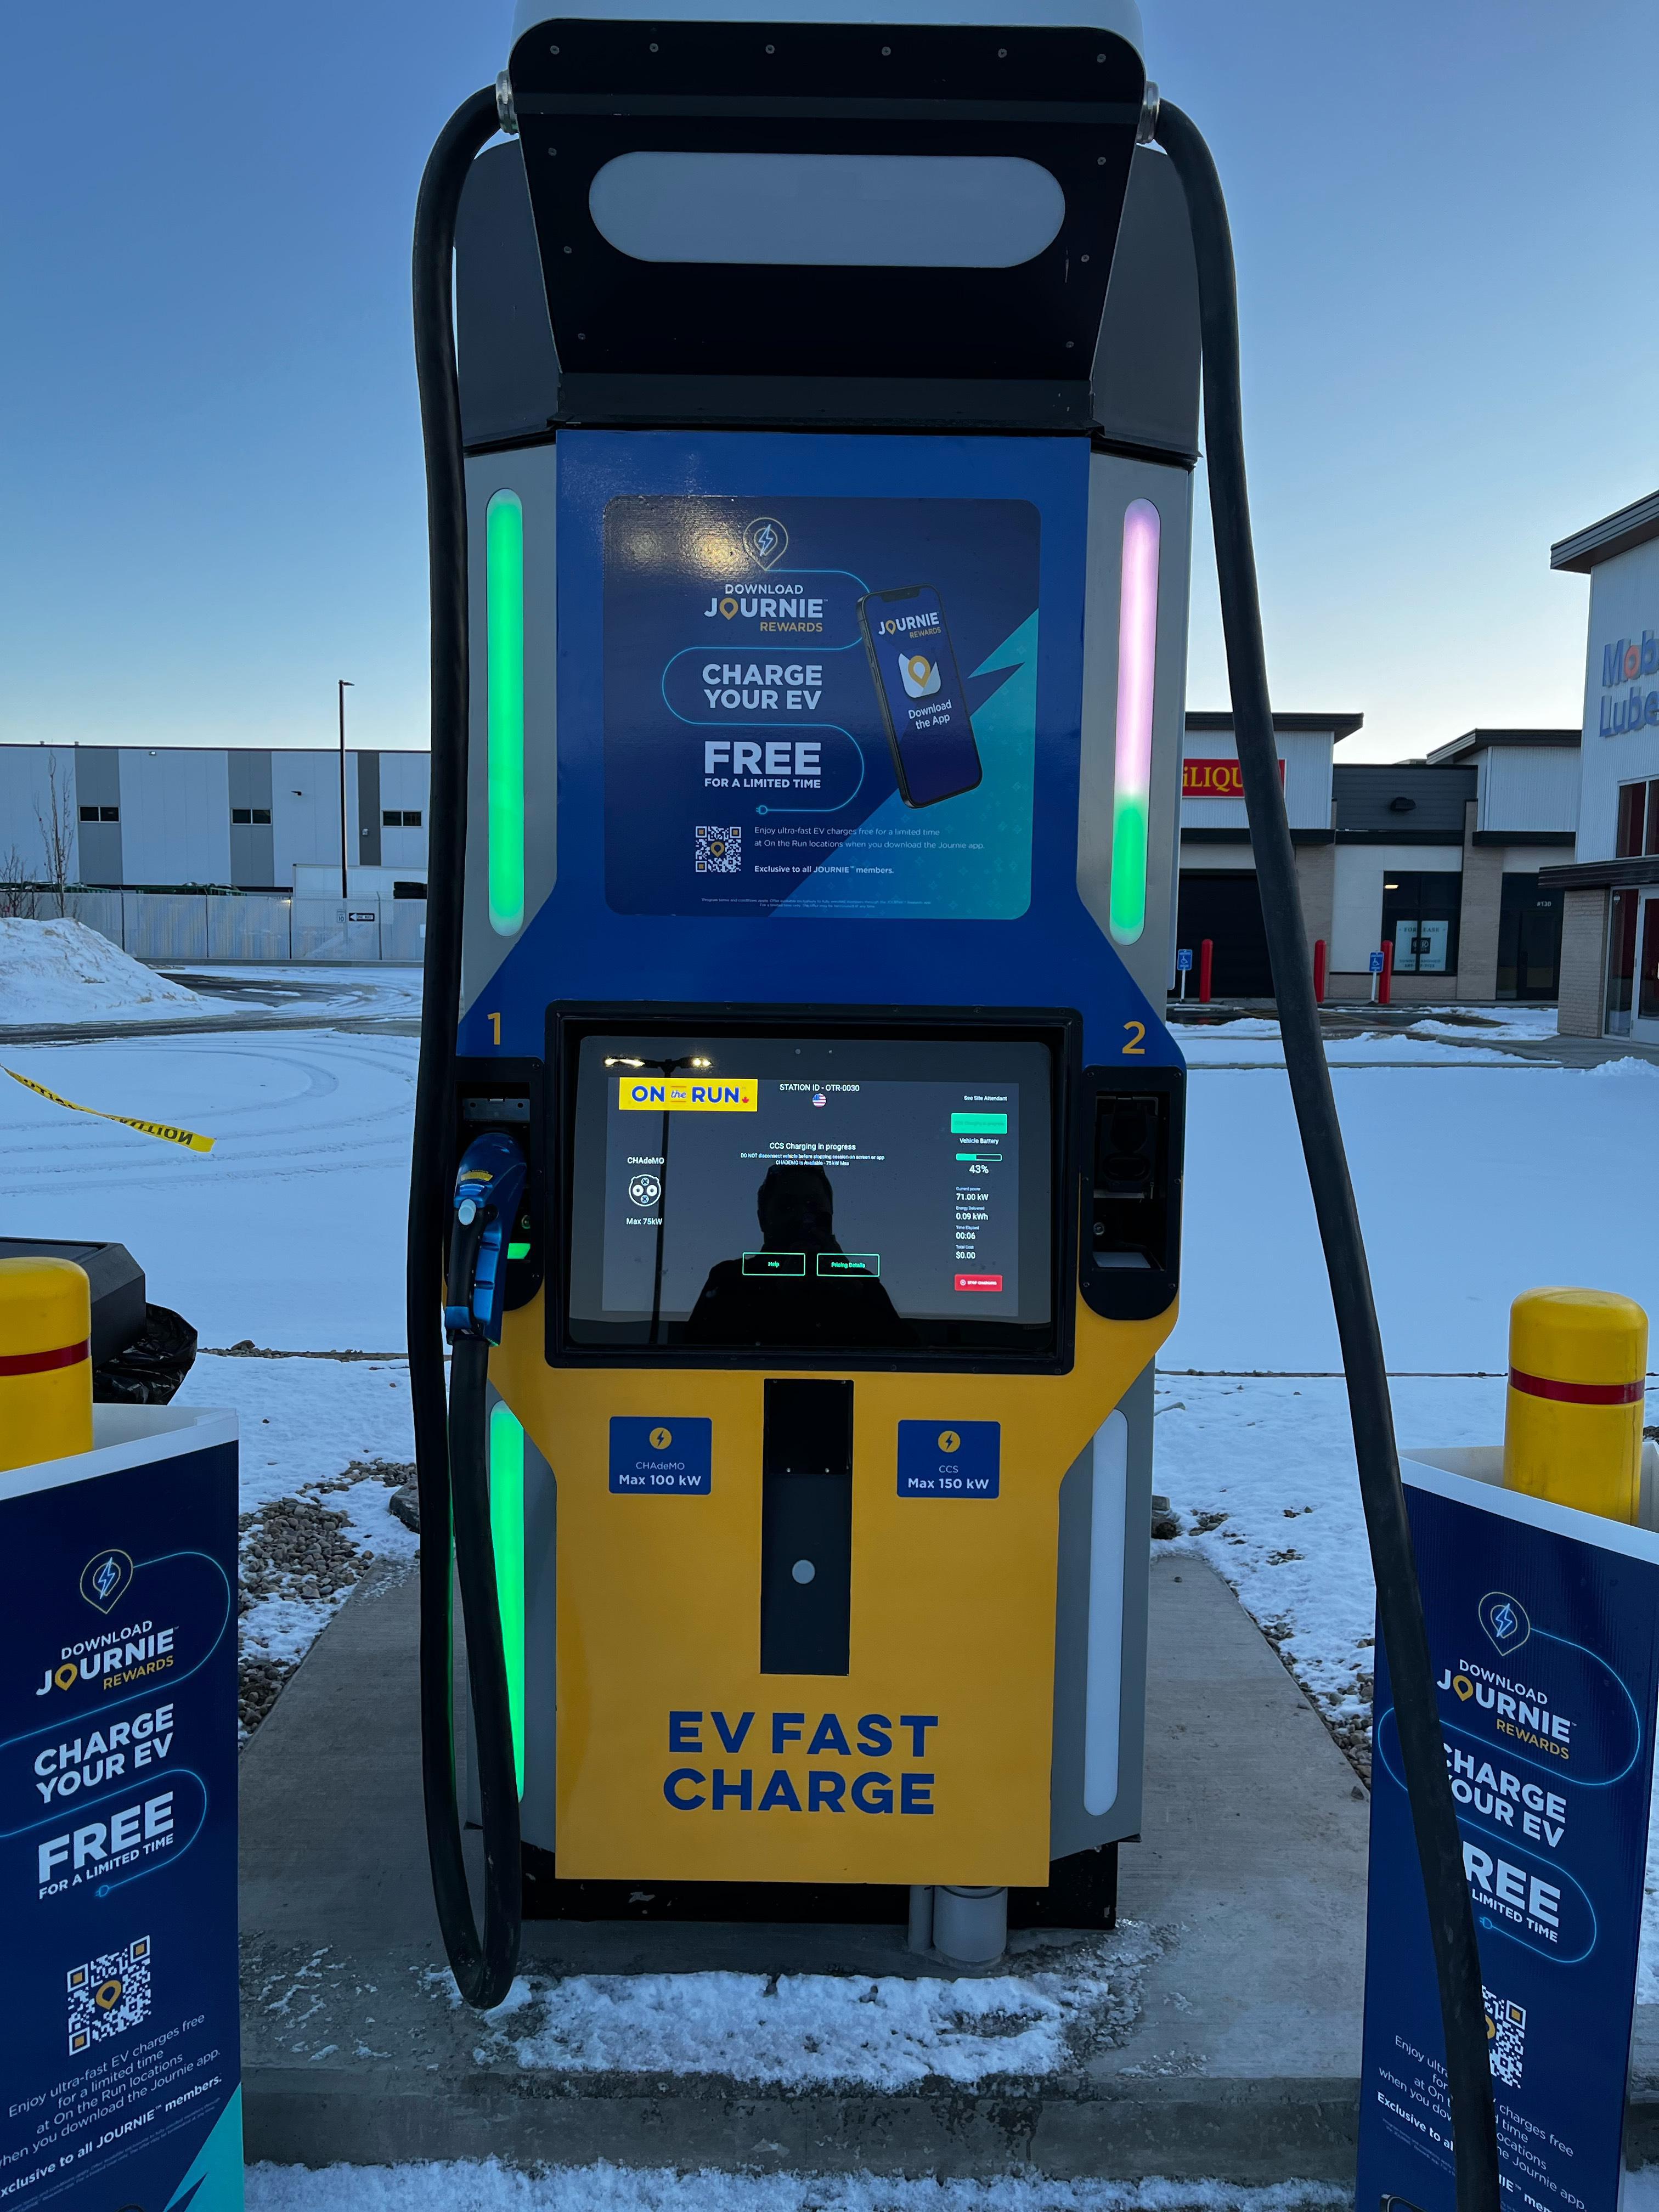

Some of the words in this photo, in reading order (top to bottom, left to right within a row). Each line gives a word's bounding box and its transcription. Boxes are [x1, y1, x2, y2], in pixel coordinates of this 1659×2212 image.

[725, 584, 803, 594] DOWNLOAD
[760, 622, 823, 632] REWARDS
[909, 627, 941, 639] REWARDS
[702, 663, 822, 686] CHARGE
[703, 689, 778, 709] YOUR
[787, 690, 822, 709] EV
[908, 699, 952, 719] Download
[916, 719, 930, 730] the
[933, 714, 950, 725] App
[705, 741, 821, 775] FREE
[705, 778, 729, 787] FOR
[732, 779, 740, 787] A
[744, 778, 790, 788] LIMITED
[793, 779, 821, 788] TIME
[754, 827, 776, 835] Enjoy
[827, 828, 856, 836] charges
[487, 1012, 500, 1045] 1
[1122, 1021, 1146, 1054] 2
[631, 1086, 665, 1102] ON
[670, 1090, 686, 1098] the
[692, 1087, 740, 1103] RUN
[786, 1142, 816, 1151] Charging
[969, 1165, 989, 1173] 43%
[956, 1251, 976, 1259] $0.00
[619, 1475, 646, 1485] Max
[650, 1475, 675, 1485] 100
[679, 1475, 702, 1486] kW
[636, 1462, 685, 1470] CHAdeMO
[939, 1465, 958, 1473] CCS
[908, 1478, 934, 1488] Max
[939, 1478, 962, 1489] 150
[967, 1479, 989, 1489] kW
[61, 1620, 153, 1660] DOWNLOAD
[103, 1655, 174, 1690] REWARDS
[1460, 1659, 1548, 1705] DOWNLOAD
[34, 1703, 173, 1776] CHARGE
[669, 1711, 755, 1753] EV
[772, 1712, 939, 1757] FAST
[1497, 1718, 1570, 1759] REWARDS
[36, 1753, 125, 1804] YOUR
[135, 1732, 173, 1769] EV
[663, 1768, 934, 1814] CHARGE
[1448, 1774, 1514, 1827] OUR
[1523, 1811, 1564, 1848] EV
[38, 1791, 173, 1884] FREE
[39, 1879, 69, 1899] FOR
[72, 1874, 82, 1886] A
[86, 1849, 140, 1880] LIMITED
[143, 1833, 174, 1855] TIME
[1463, 1841, 1561, 1928] REE
[1472, 1888, 1523, 1923] LIMITED
[1526, 1917, 1559, 1943] TIME
[9, 2093, 46, 2118] Enjoy
[50, 2062, 108, 2097] ultra-fast
[111, 2050, 129, 2068] EV
[132, 2027, 179, 2057] charges
[183, 2015, 205, 2032] free
[58, 2093, 76, 2109] for
[80, 2088, 88, 2098] a
[92, 2062, 133, 2092] limited
[137, 2050, 163, 2069] time
[32, 2132, 57, 2154] you
[61, 2096, 124, 2137] download
[128, 2087, 148, 2103] the
[151, 2063, 194, 2091] Journie
[196, 2049, 221, 2067] app.
[37, 2120, 50, 2134] at
[54, 2110, 74, 2125] On
[77, 2098, 98, 2114] the
[102, 2083, 126, 2102] Run
[130, 2053, 183, 2087] locations
[1395, 2035, 1424, 2062] Enjoy
[1499, 2105, 1546, 2140] charges
[1550, 2134, 1573, 2157] free
[1414, 2078, 1425, 2090] at
[1428, 2086, 1444, 2103] On
[1378, 2091, 1426, 2132] Exclusive
[1429, 2127, 1441, 2141] to
[1379, 2067, 1407, 2092] when
[1410, 2088, 1429, 2107] you
[1513, 2157, 1557, 2192] Journie
[1503, 2119, 1528, 2143] time
[0, 2163, 56, 2198] xclusive
[60, 2154, 74, 2167] to
[77, 2141, 93, 2158] all
[165, 2076, 222, 2112] members.
